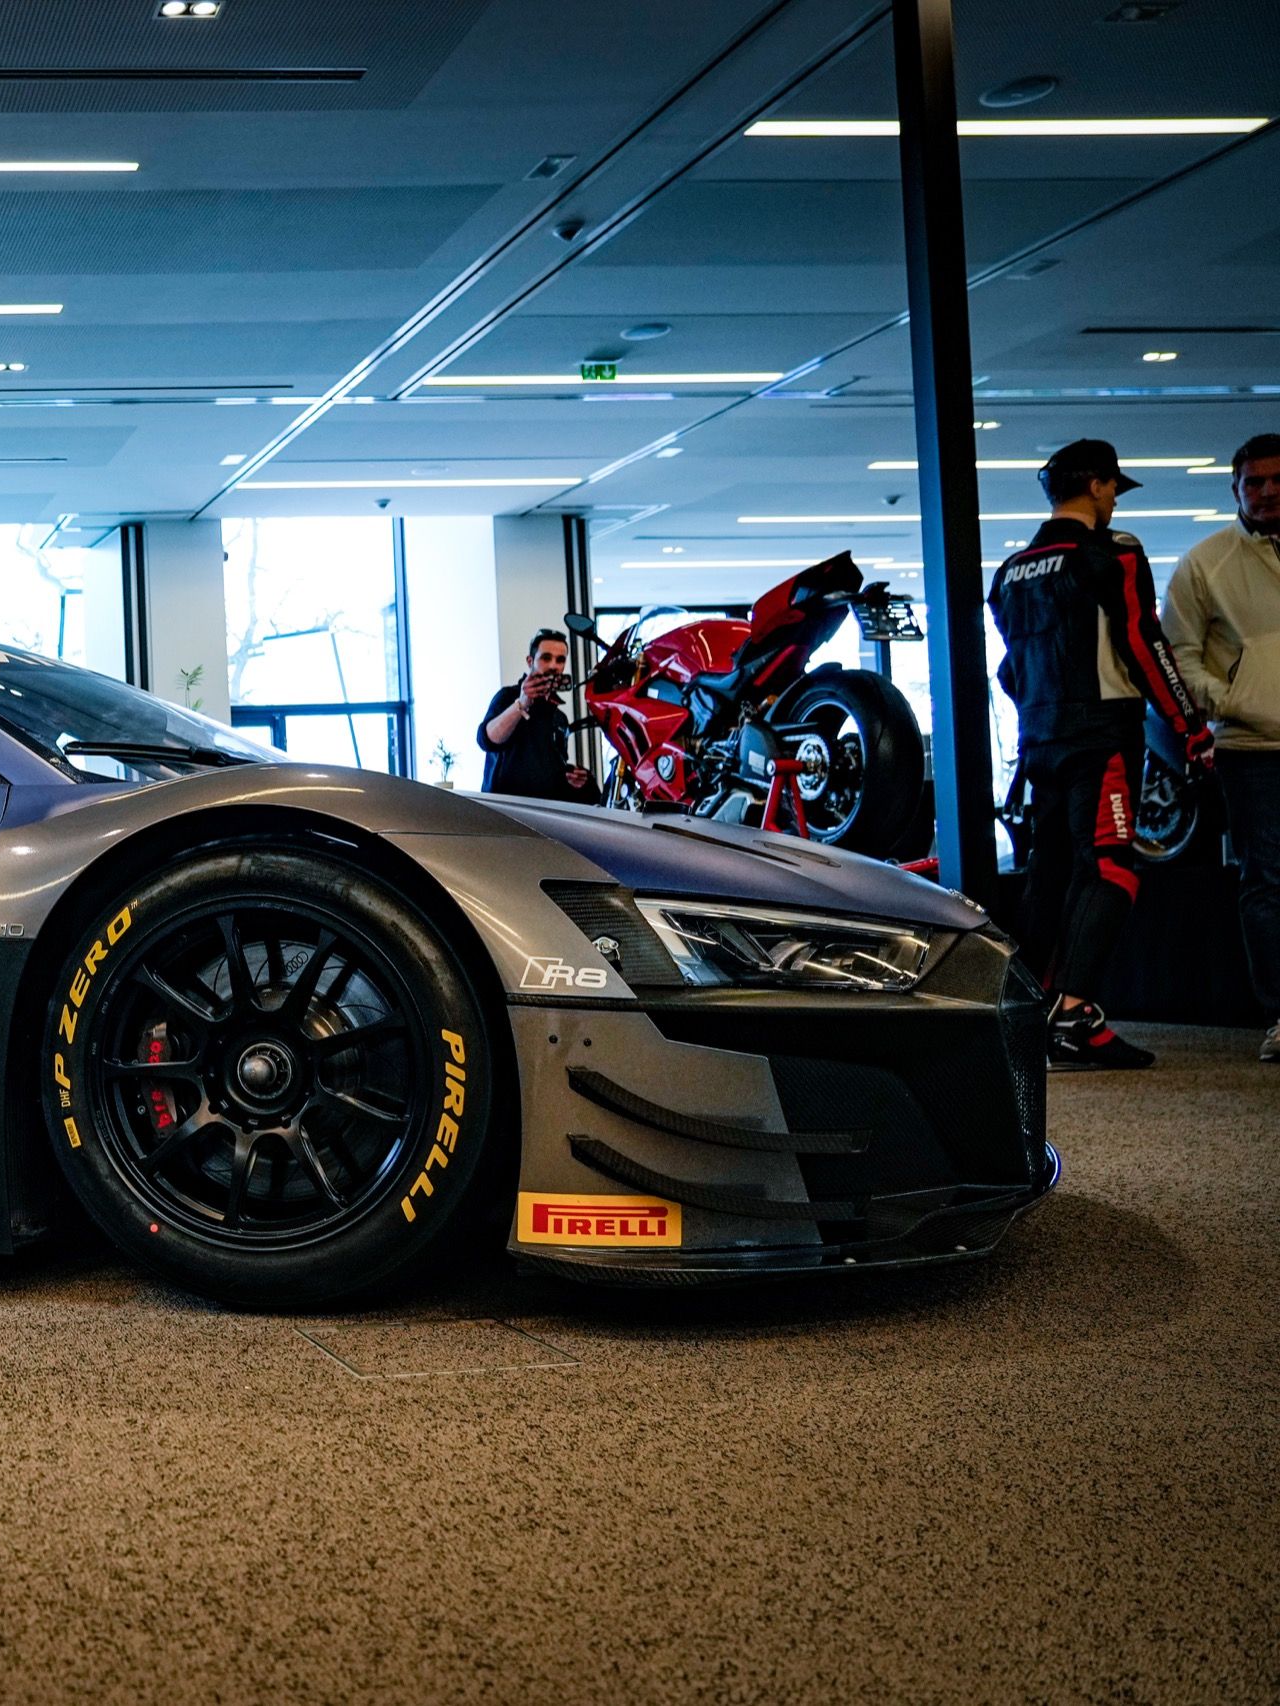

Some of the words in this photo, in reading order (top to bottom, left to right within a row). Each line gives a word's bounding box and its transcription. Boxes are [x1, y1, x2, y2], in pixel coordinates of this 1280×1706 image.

[1003, 554, 1064, 586] DUCATI
[1153, 640, 1180, 685] DUCATI
[58, 906, 132, 1045] ZERO
[540, 964, 608, 988] R8
[59, 1089, 71, 1108] DHF
[400, 1028, 467, 1223] PIRELLI
[532, 1203, 669, 1237] PIRELLI
